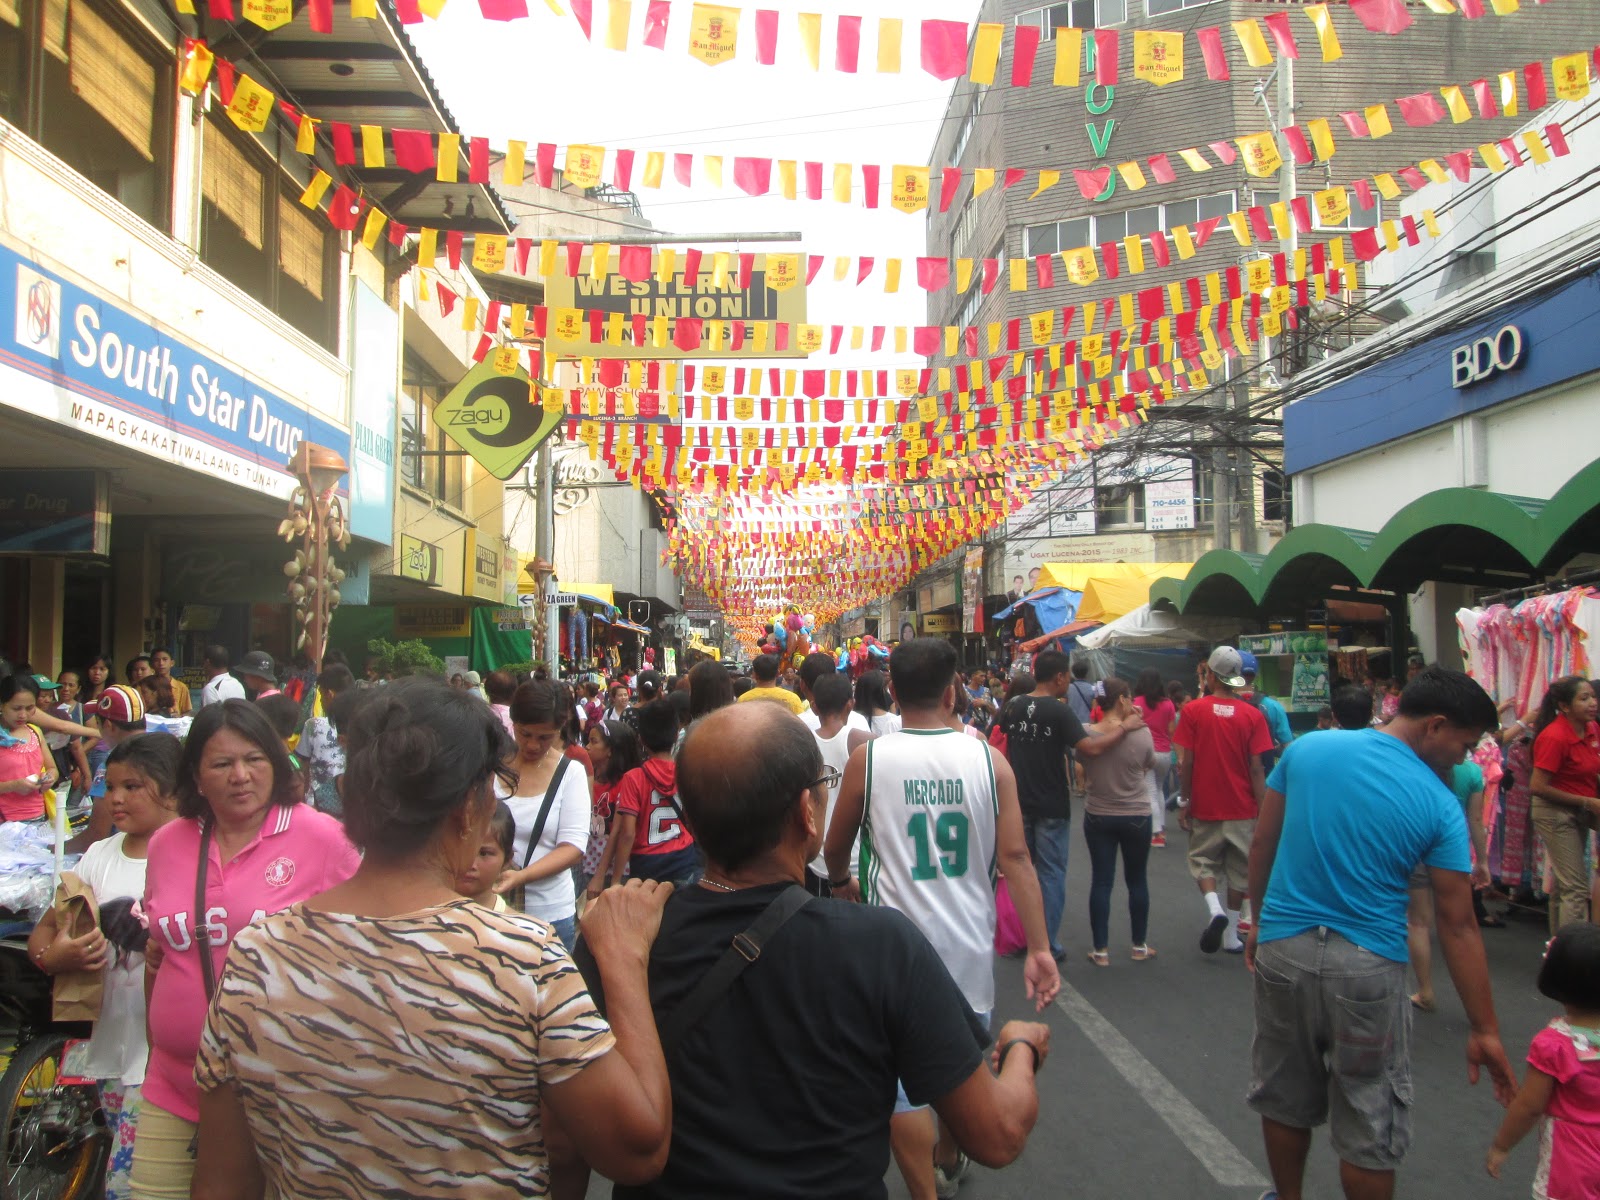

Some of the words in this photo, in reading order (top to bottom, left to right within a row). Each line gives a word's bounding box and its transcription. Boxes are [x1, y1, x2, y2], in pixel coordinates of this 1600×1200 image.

[247, 1, 261, 12] San
[264, 0, 289, 14] Miguel
[692, 40, 709, 50] San
[709, 41, 734, 52] Miguel
[1155, 63, 1180, 72] Miguel
[894, 194, 905, 202] San
[906, 194, 926, 204] Miguel
[577, 273, 742, 296] WESTERN
[630, 296, 742, 318] UNION
[1452, 324, 1521, 388] BDO
[70, 303, 179, 405] South
[188, 364, 245, 432] Star
[248, 394, 303, 465] Drug
[446, 408, 502, 426] Zagu
[70, 402, 239, 476] MAPAGKAKATIWALAANG
[246, 467, 278, 487] TUNAY
[355, 420, 374, 457] PLAZA
[375, 433, 393, 467] GREEN
[1152, 498, 1186, 507] 710-4456
[1051, 549, 1100, 558] LUCENA-2015
[556, 595, 576, 604] GREEN
[903, 778, 963, 805] MERCADO
[907, 811, 969, 881] 19
